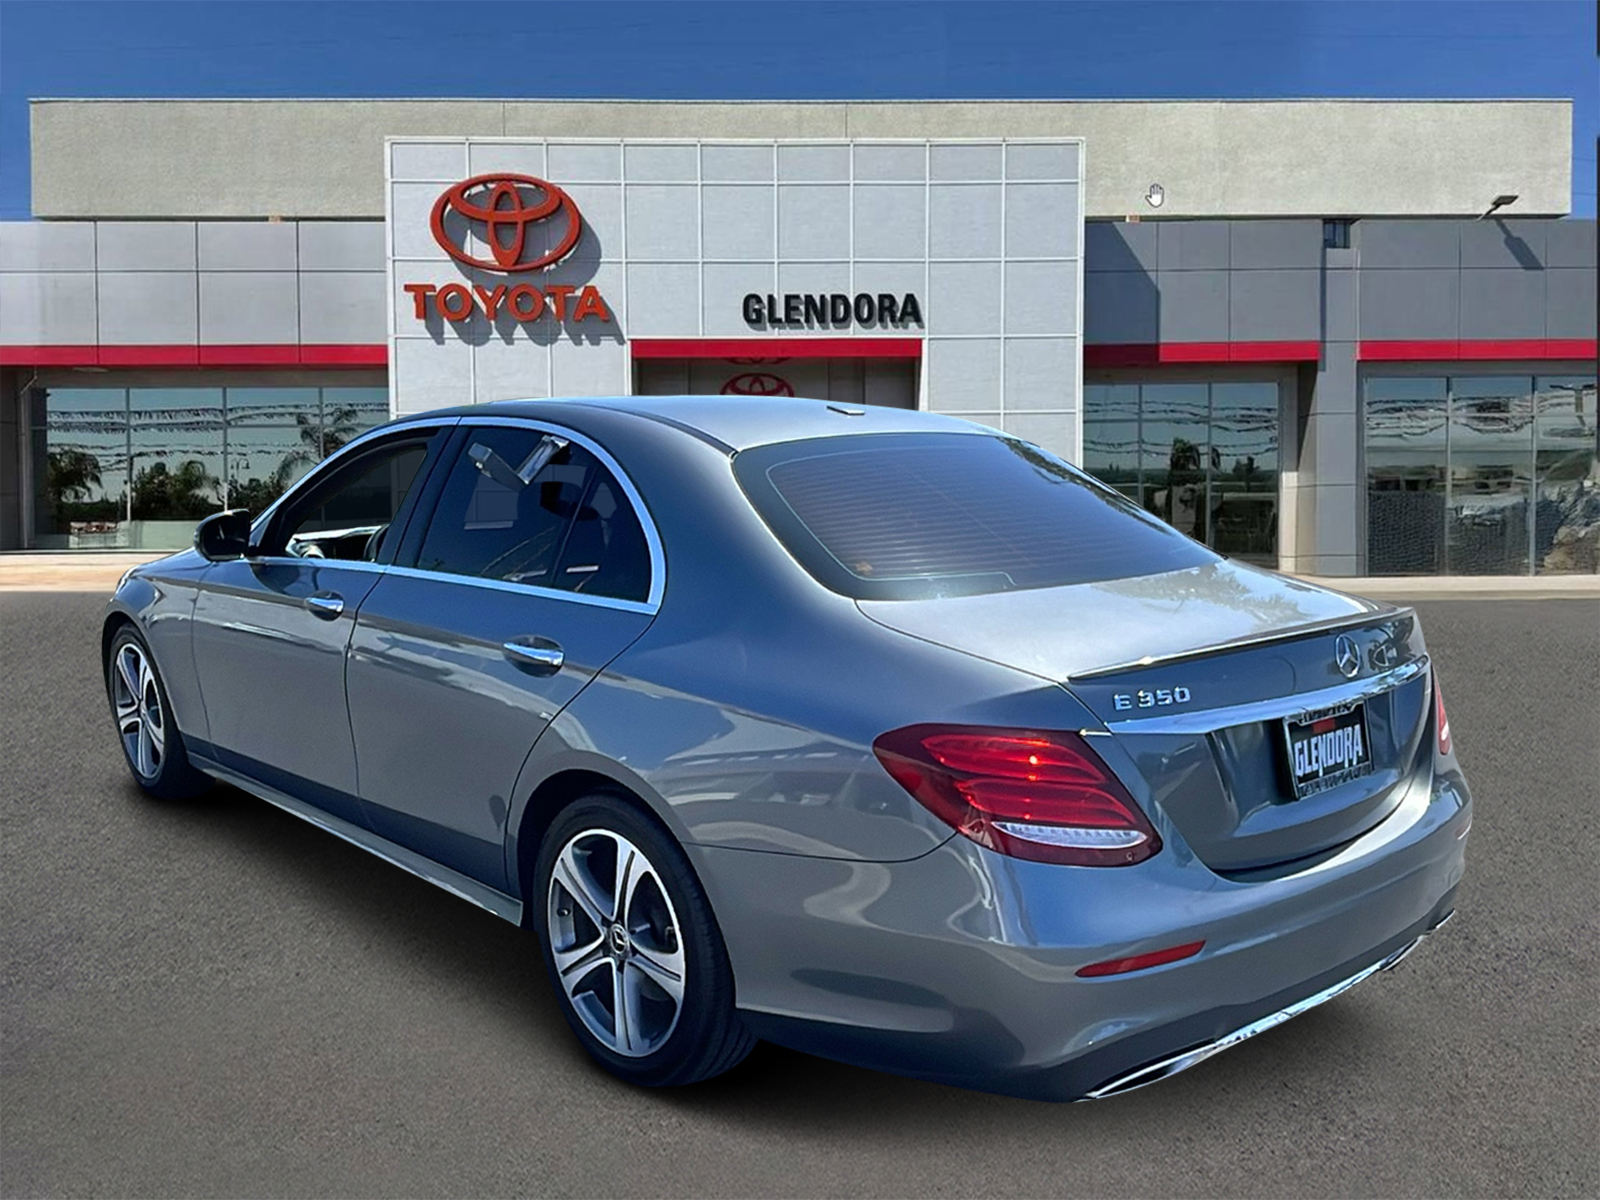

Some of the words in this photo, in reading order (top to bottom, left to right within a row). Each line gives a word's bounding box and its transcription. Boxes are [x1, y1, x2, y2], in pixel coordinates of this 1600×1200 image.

[404, 283, 610, 322] TOYOTA
[742, 293, 923, 325] GLENDORA
[1114, 694, 1132, 710] E
[1138, 686, 1190, 708] 350
[1294, 724, 1362, 777] GLENDORA
